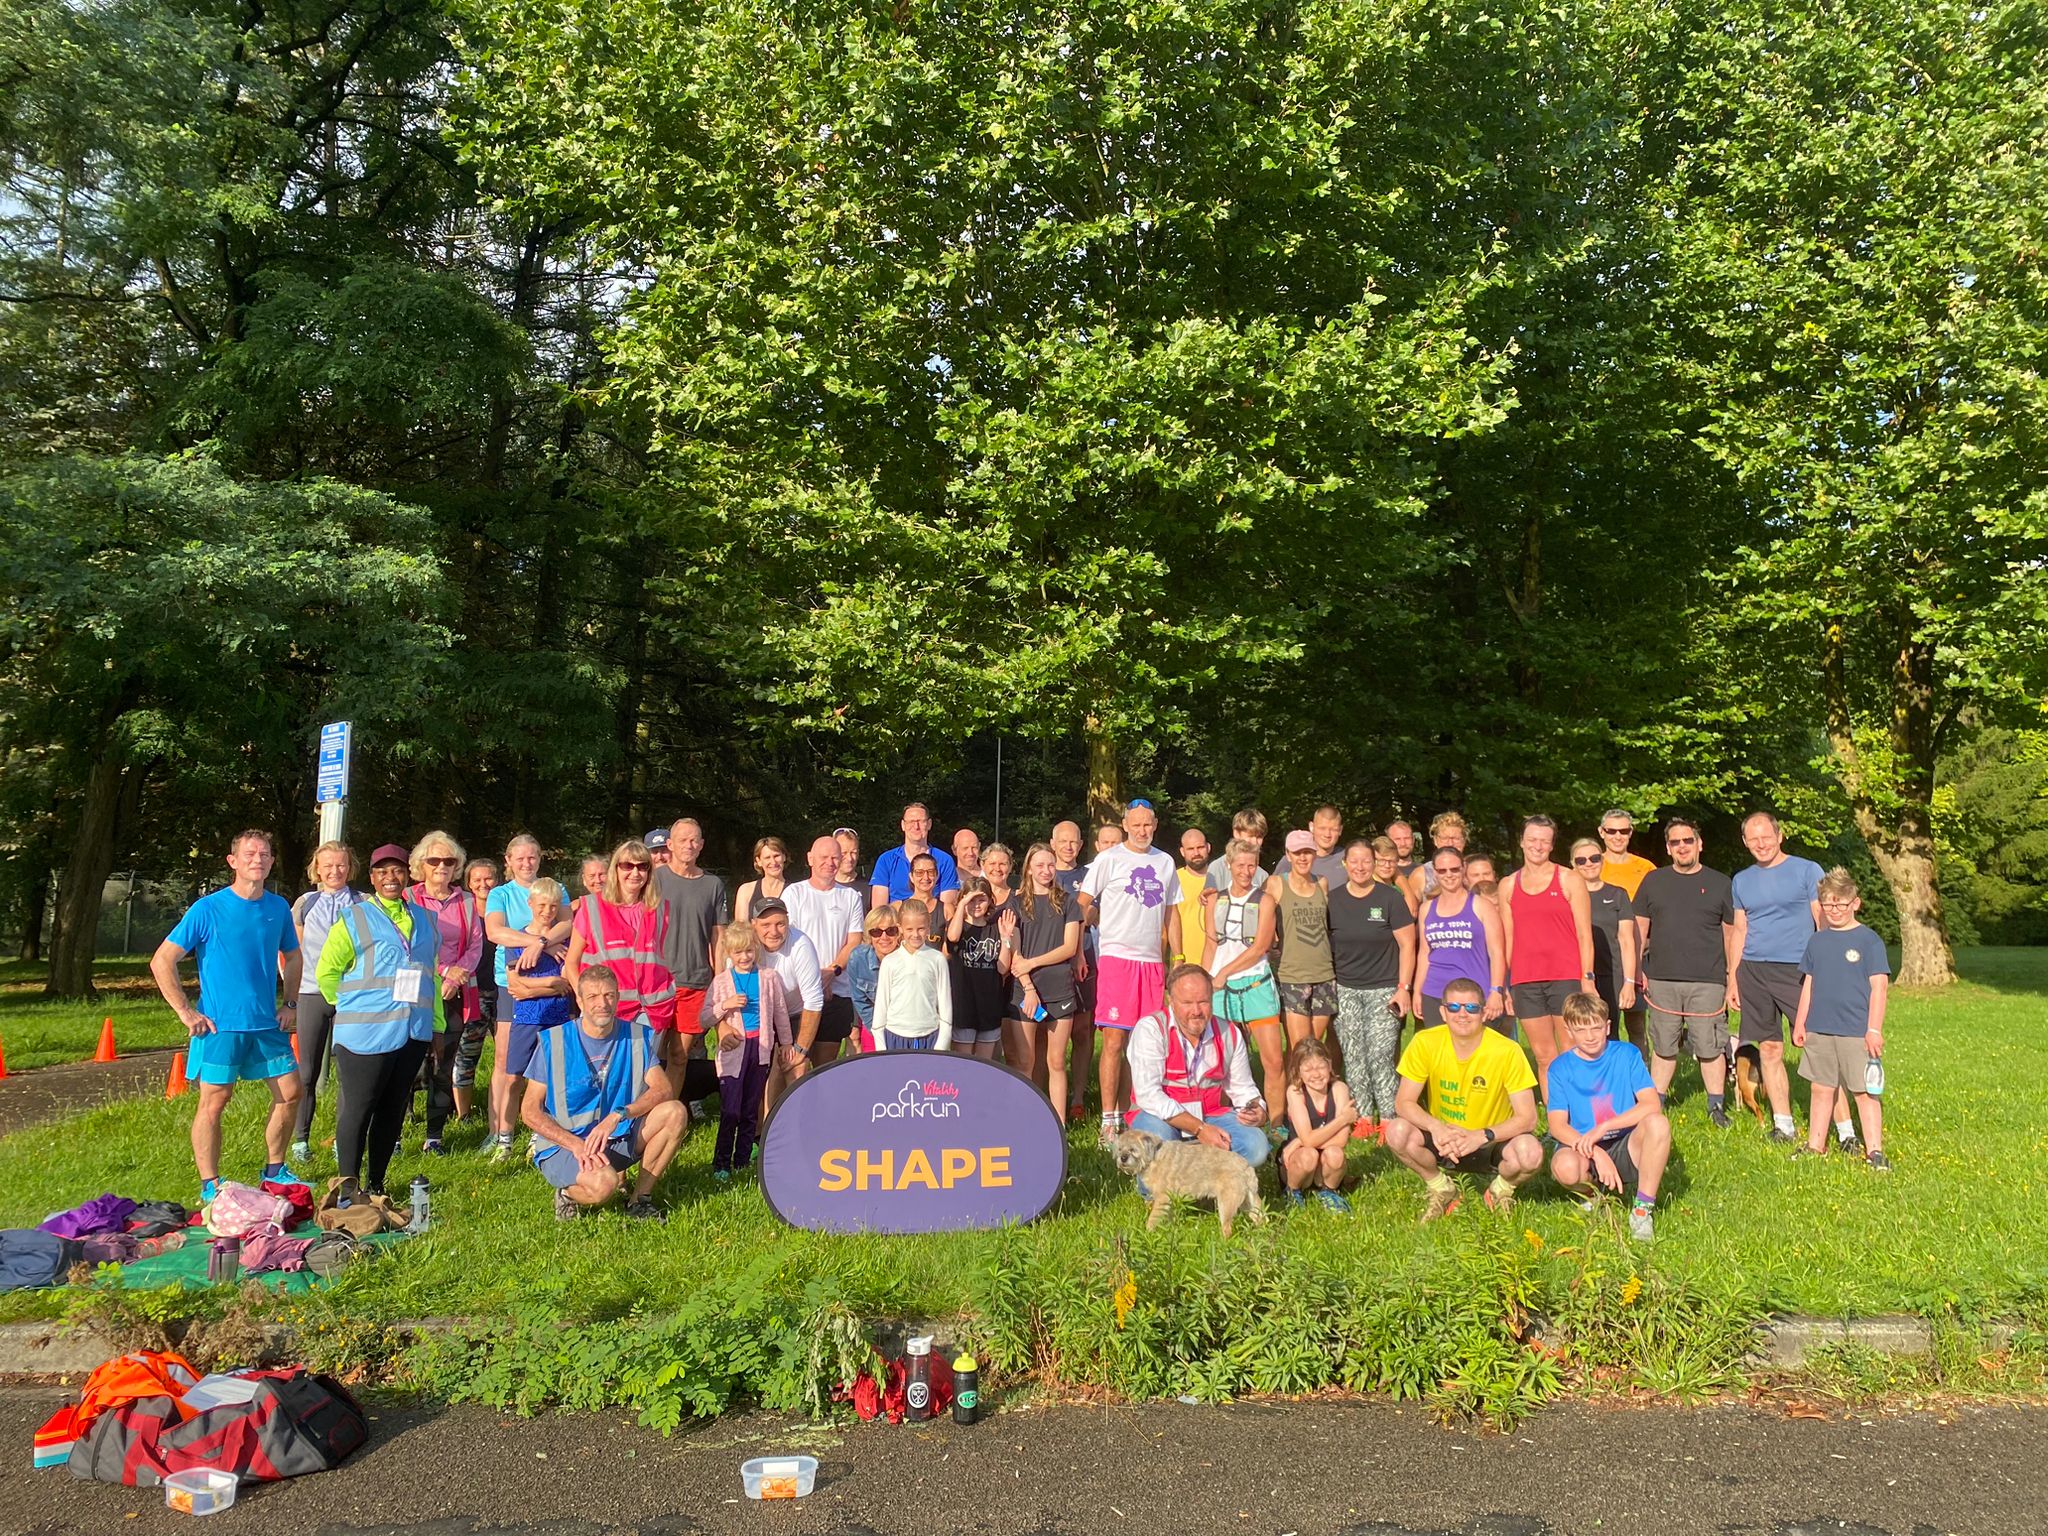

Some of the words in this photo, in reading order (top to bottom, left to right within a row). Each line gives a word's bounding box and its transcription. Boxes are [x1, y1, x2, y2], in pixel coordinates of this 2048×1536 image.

[1426, 930, 1472, 941] STRONG
[923, 1079, 959, 1100] Vitality
[871, 1092, 960, 1123] parkrun
[818, 1146, 1014, 1192] SHAPE
